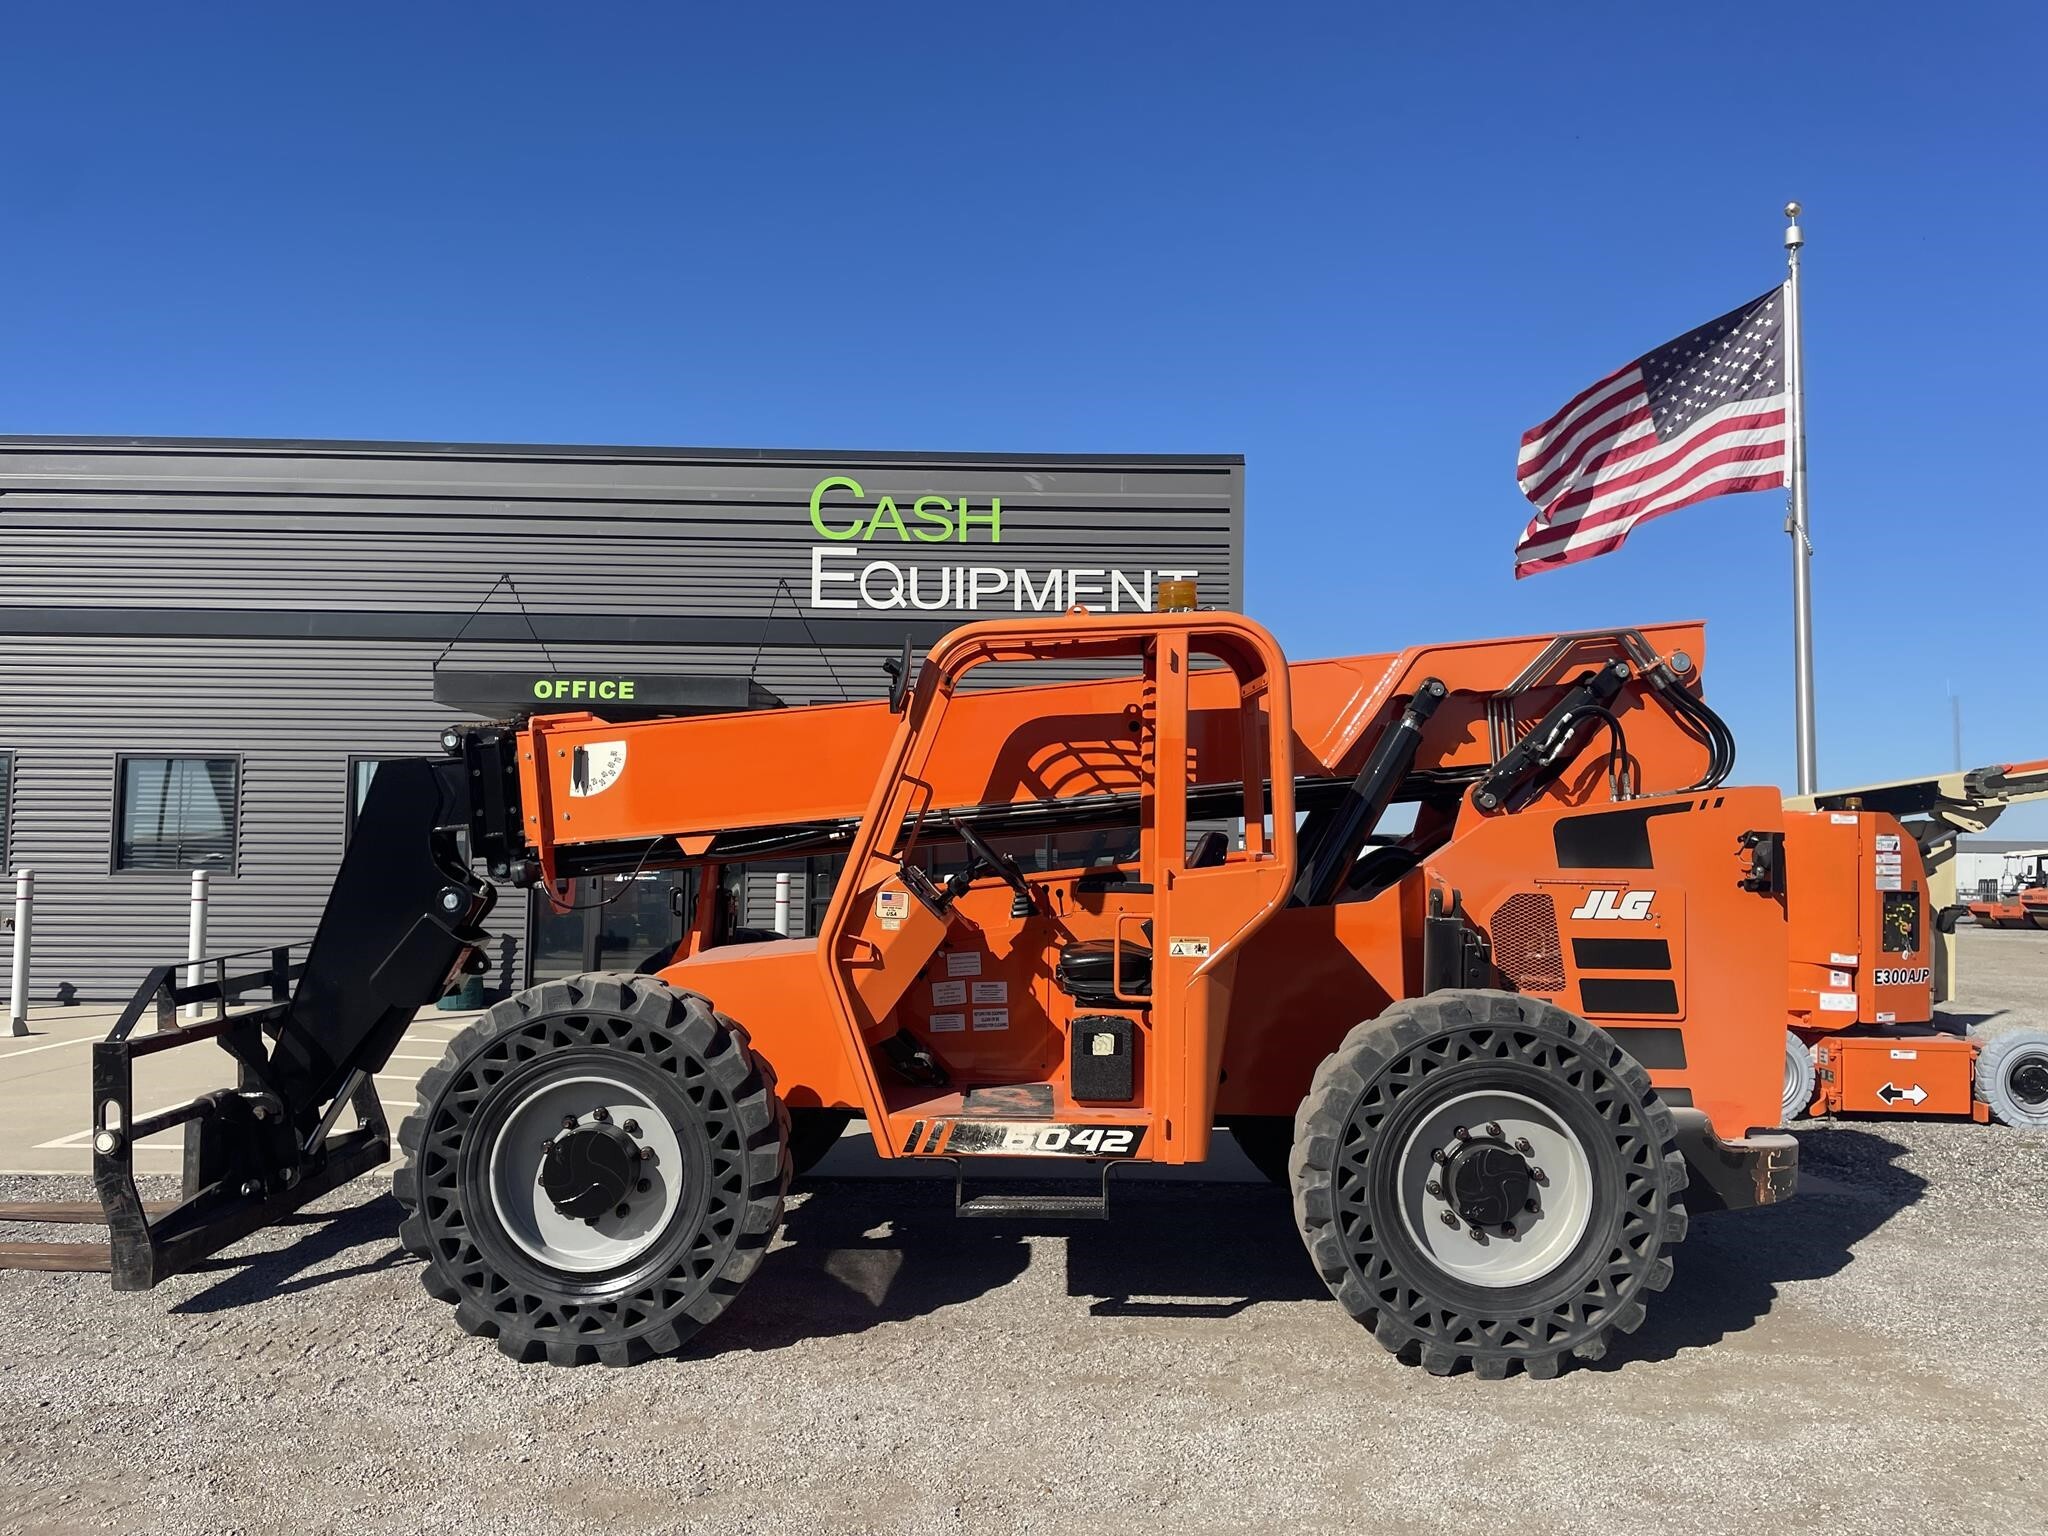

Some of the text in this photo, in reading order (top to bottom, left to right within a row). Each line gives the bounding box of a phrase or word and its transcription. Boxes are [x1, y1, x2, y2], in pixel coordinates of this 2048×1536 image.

[810, 476, 1000, 543] CASH
[533, 680, 635, 700] OFFICE
[1570, 889, 1657, 920] JLG
[1874, 967, 1931, 986] E300AJP
[1001, 1128, 1134, 1153] 6042
